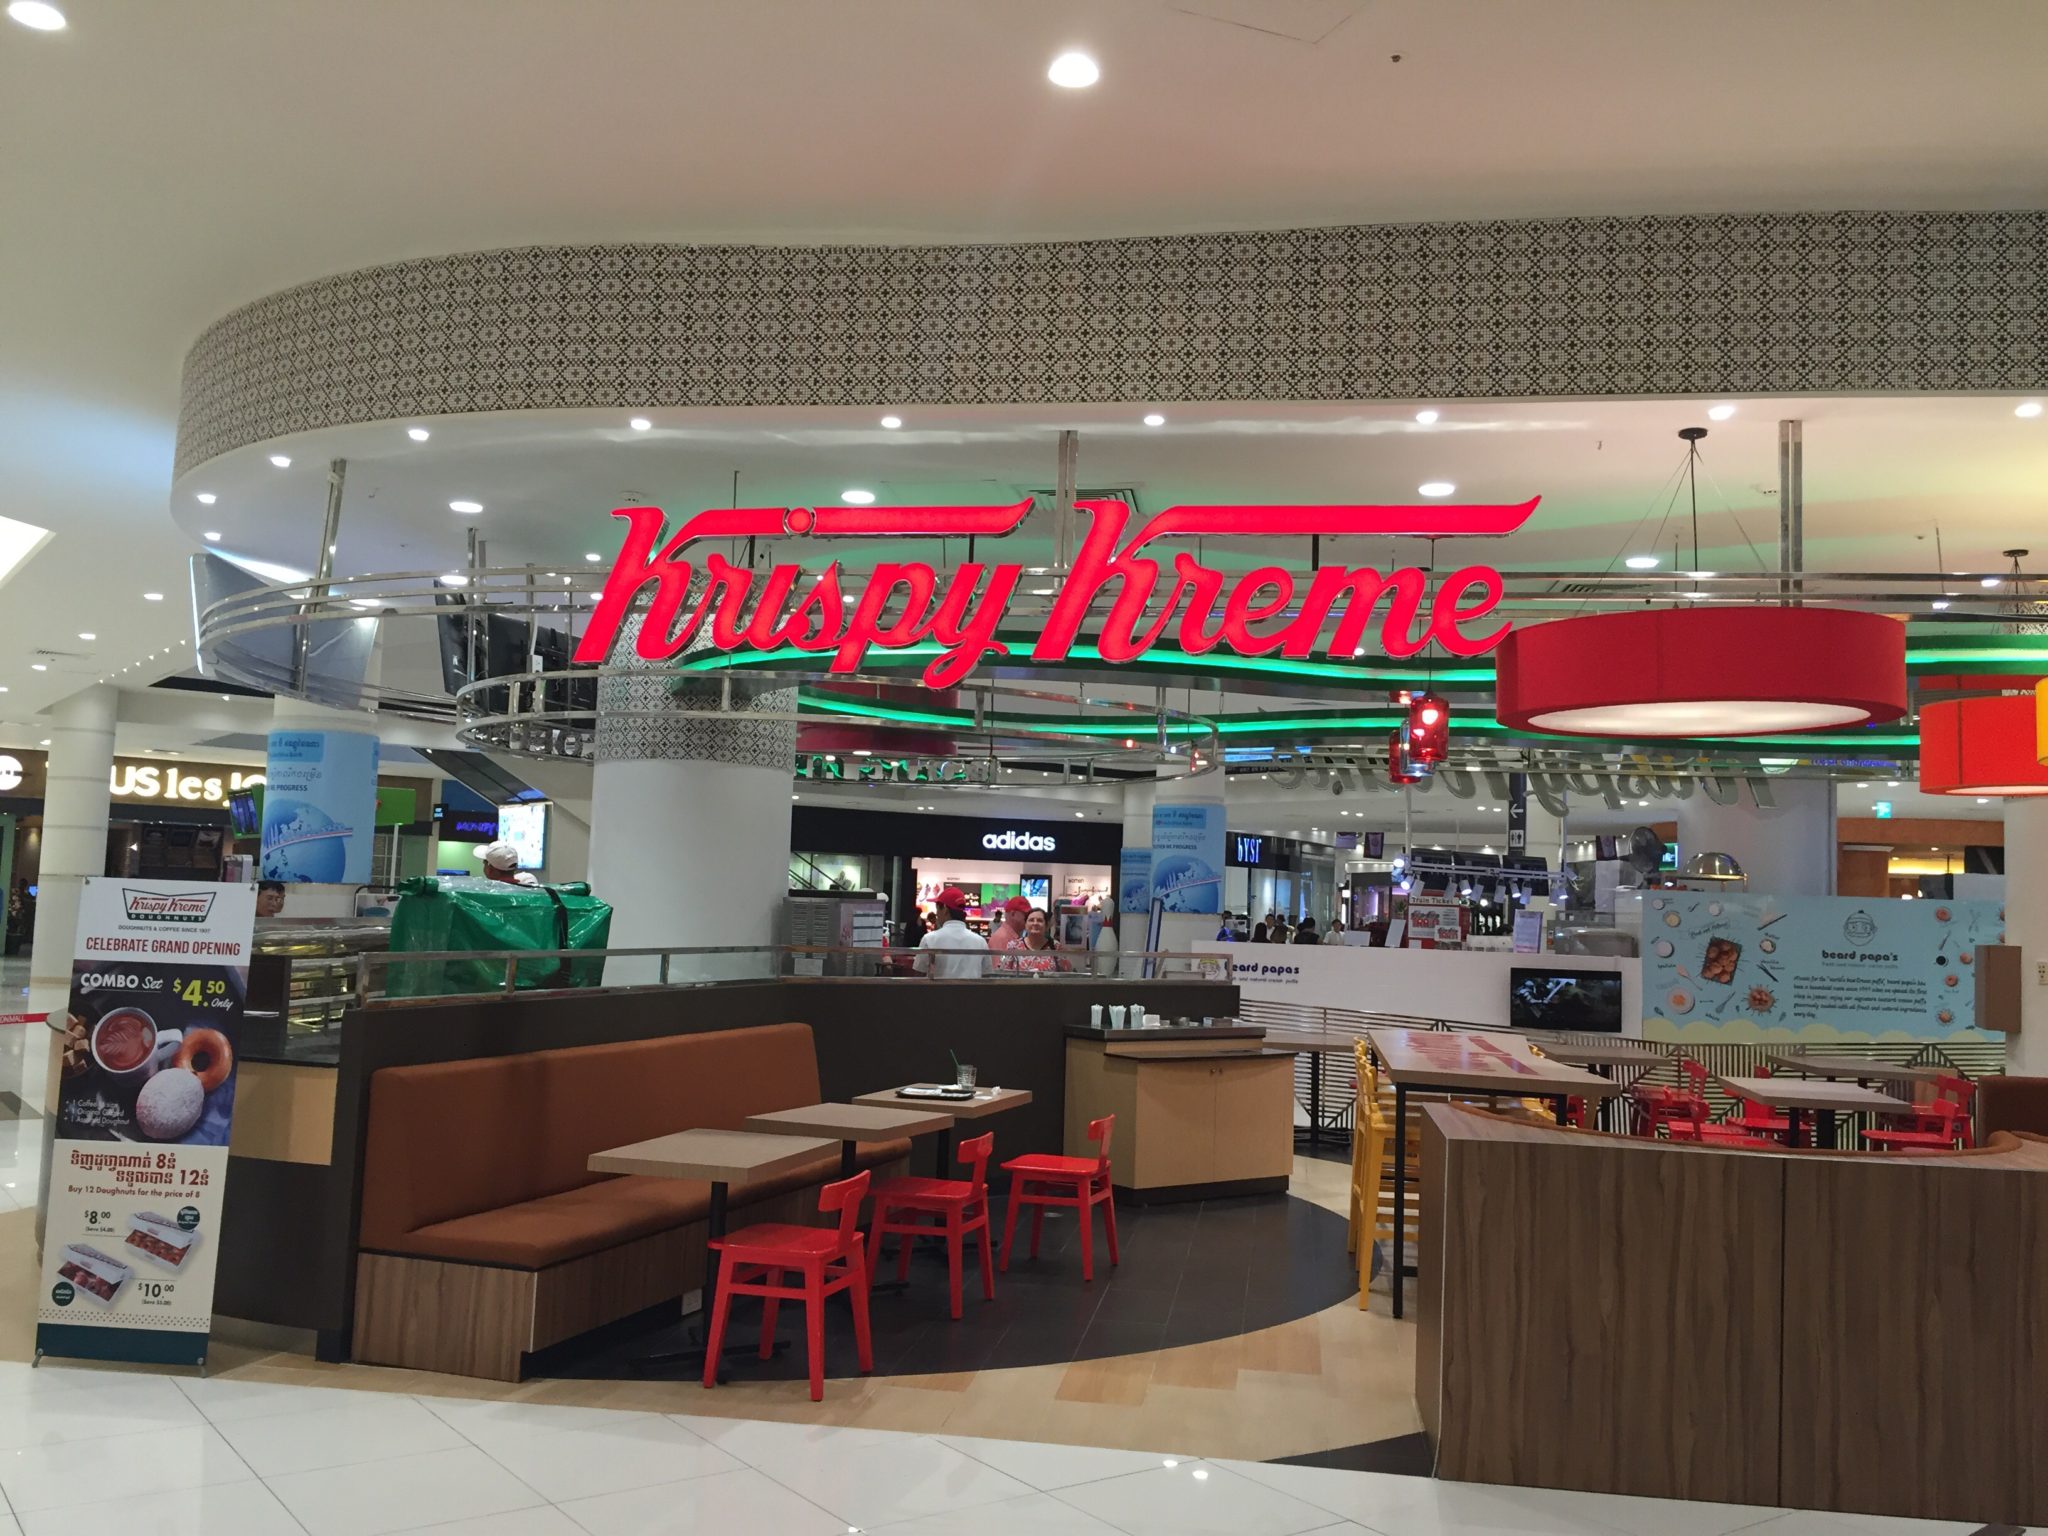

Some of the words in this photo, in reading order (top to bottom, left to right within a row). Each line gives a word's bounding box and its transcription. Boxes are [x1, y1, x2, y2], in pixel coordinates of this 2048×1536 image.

[572, 497, 1035, 690] Krispy
[1031, 495, 1542, 664] Kreme
[164, 768, 223, 801] les
[982, 830, 1056, 851] adidas
[129, 896, 169, 913] Krispy
[167, 898, 208, 912] Kreme
[131, 913, 203, 921] DOUGHNUTS
[86, 937, 148, 952] CELEBRATE
[152, 940, 189, 954] GRAND
[192, 941, 240, 956] OPENING
[1822, 949, 1856, 960] beard
[1860, 951, 1898, 963] papa's
[80, 973, 139, 988] COMBO
[142, 976, 163, 989] Set
[211, 998, 233, 1010] Only
[68, 1185, 82, 1194] Buy
[96, 1187, 136, 1197] Doughnuts
[150, 1188, 162, 1196] the
[164, 1190, 183, 1198] price
[185, 1190, 194, 1198] of
